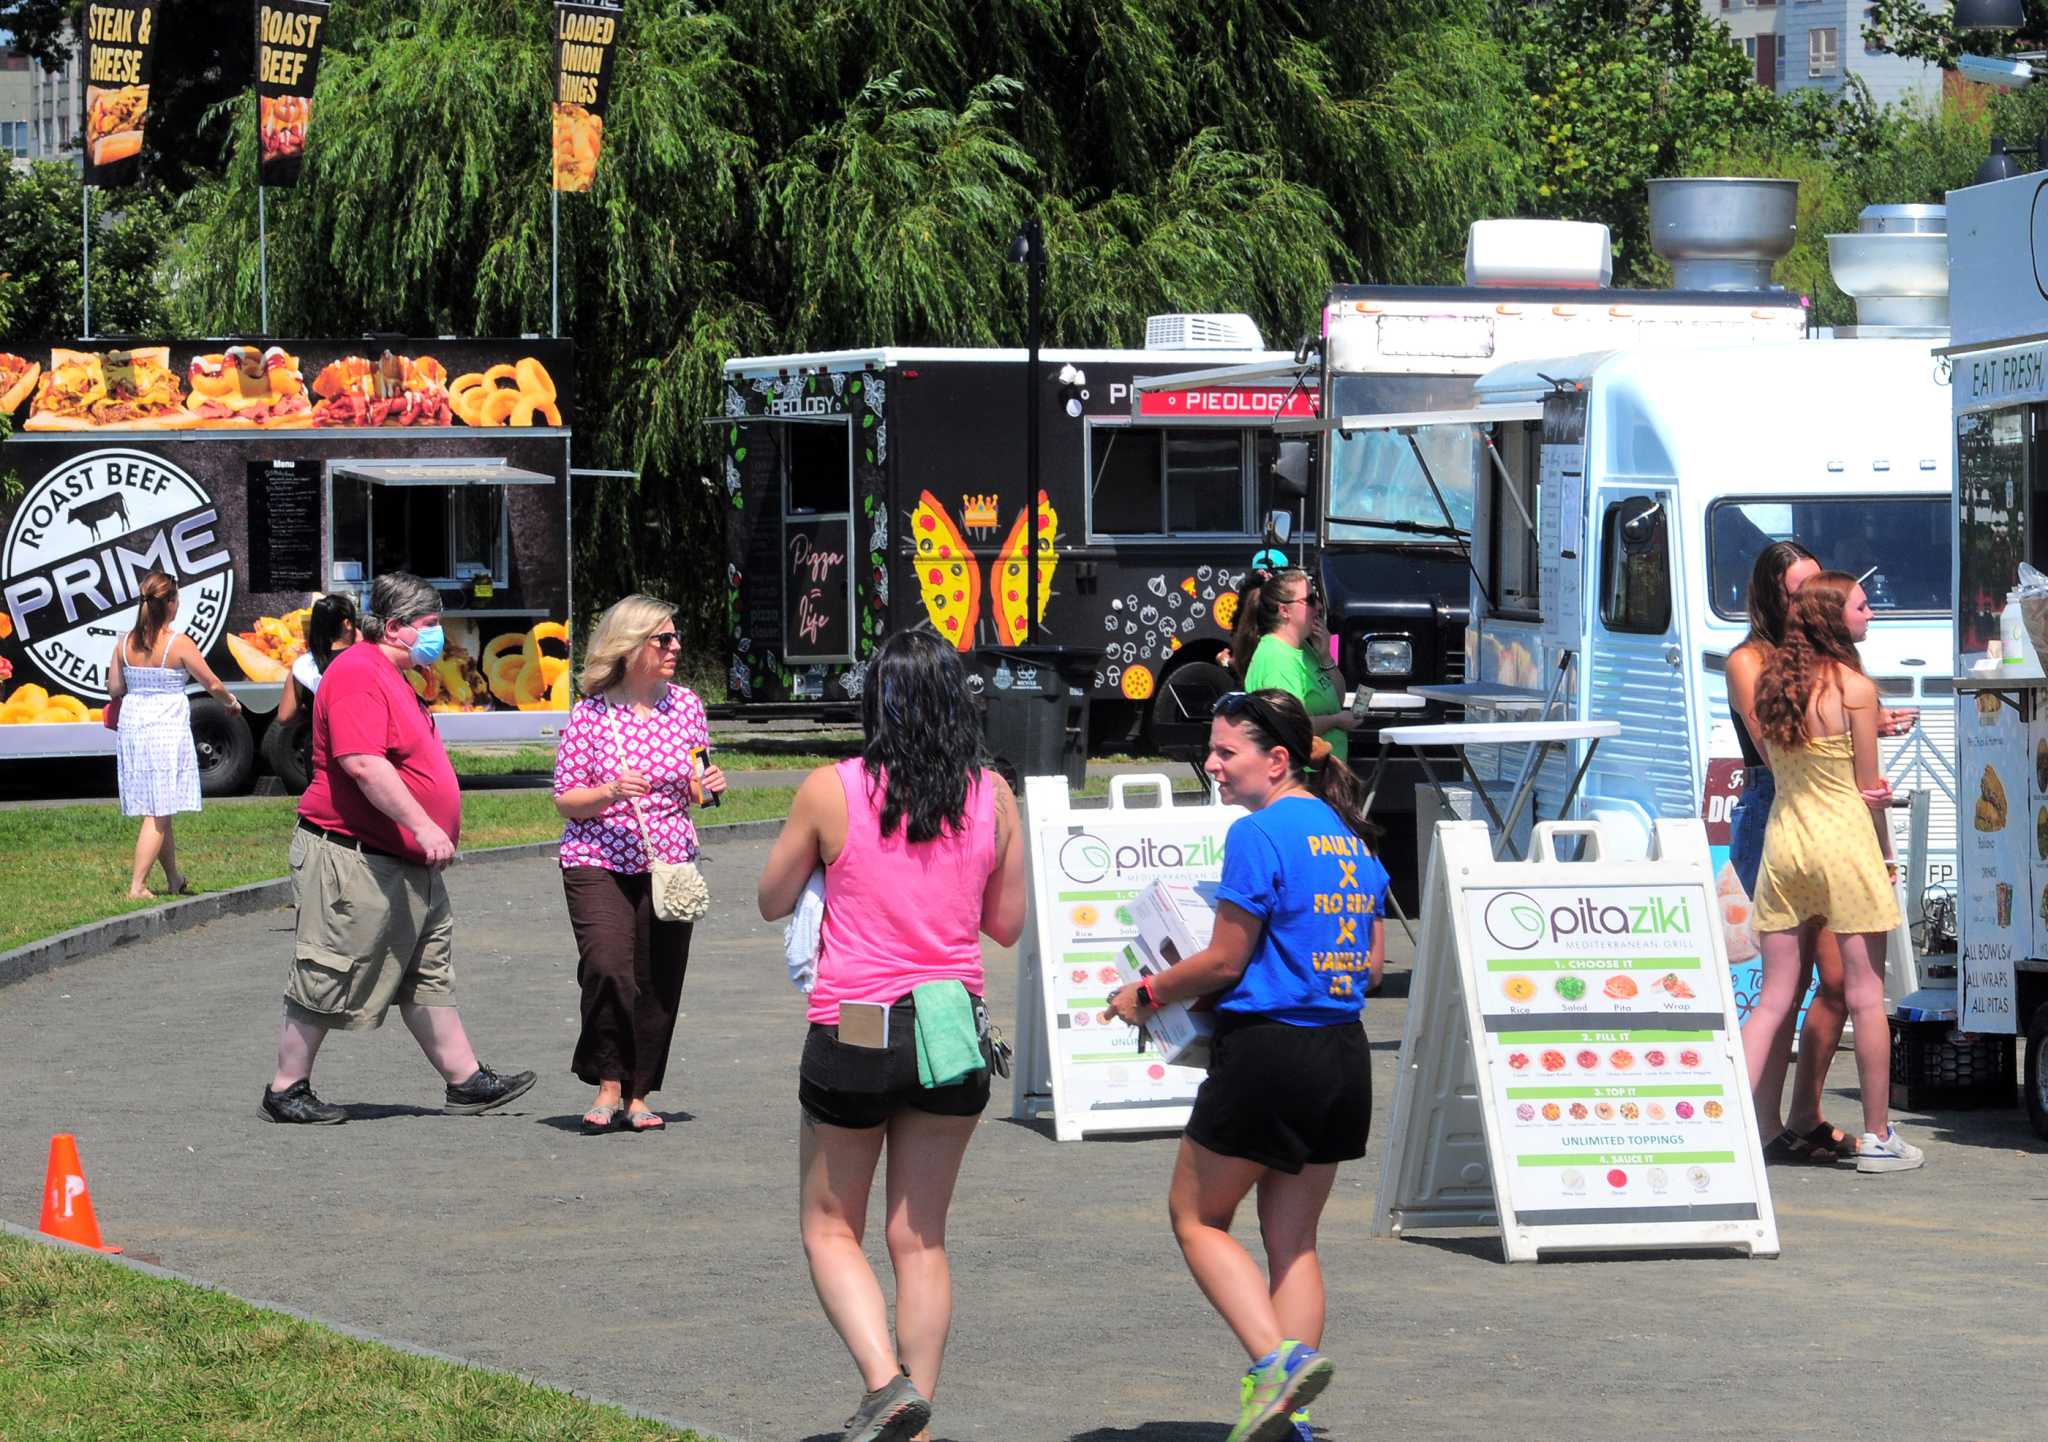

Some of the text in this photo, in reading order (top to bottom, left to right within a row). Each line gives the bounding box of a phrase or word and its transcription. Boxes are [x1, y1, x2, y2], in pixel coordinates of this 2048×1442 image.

[88, 3, 151, 45] STEAK &
[260, 5, 321, 48] ROAST
[559, 9, 616, 45] LOADED
[89, 43, 143, 84] CHEESE
[259, 46, 308, 86] BEEF
[561, 41, 604, 74] ONION
[559, 71, 599, 105] RINGS
[1972, 360, 1997, 397] EAT
[1186, 392, 1299, 411] PIEOLOGY
[19, 462, 171, 550] ROAST BEEF
[789, 532, 844, 583] Pizza
[3, 508, 231, 643] PRIME
[184, 586, 220, 645] EESE
[799, 594, 830, 645] Life
[44, 640, 110, 688] STEA
[1115, 835, 1227, 877] pitazik
[1307, 835, 1359, 857] PAULY
[1313, 893, 1344, 915] FLO
[1549, 896, 1691, 944] pitaziki
[1565, 939, 1694, 950] MEDITERRANEAN GRILL
[1964, 942, 2007, 961] ALL BOWLS
[1567, 959, 1619, 969] CHOOSE
[1621, 958, 1633, 968] IT
[1967, 971, 2009, 989] ALL WRAPS
[1510, 1001, 1691, 1014] Rice Salad Pita Wrap
[1971, 996, 2010, 1014] ALL PITAS
[1595, 1032, 1616, 1042] FILL
[1619, 1031, 1630, 1041] IT
[1606, 1086, 1626, 1097] TOP
[1561, 1134, 1685, 1147] UNLIMITED TOPPINGS
[1611, 1154, 1642, 1165] SAUCE
[63, 1173, 86, 1218] P
